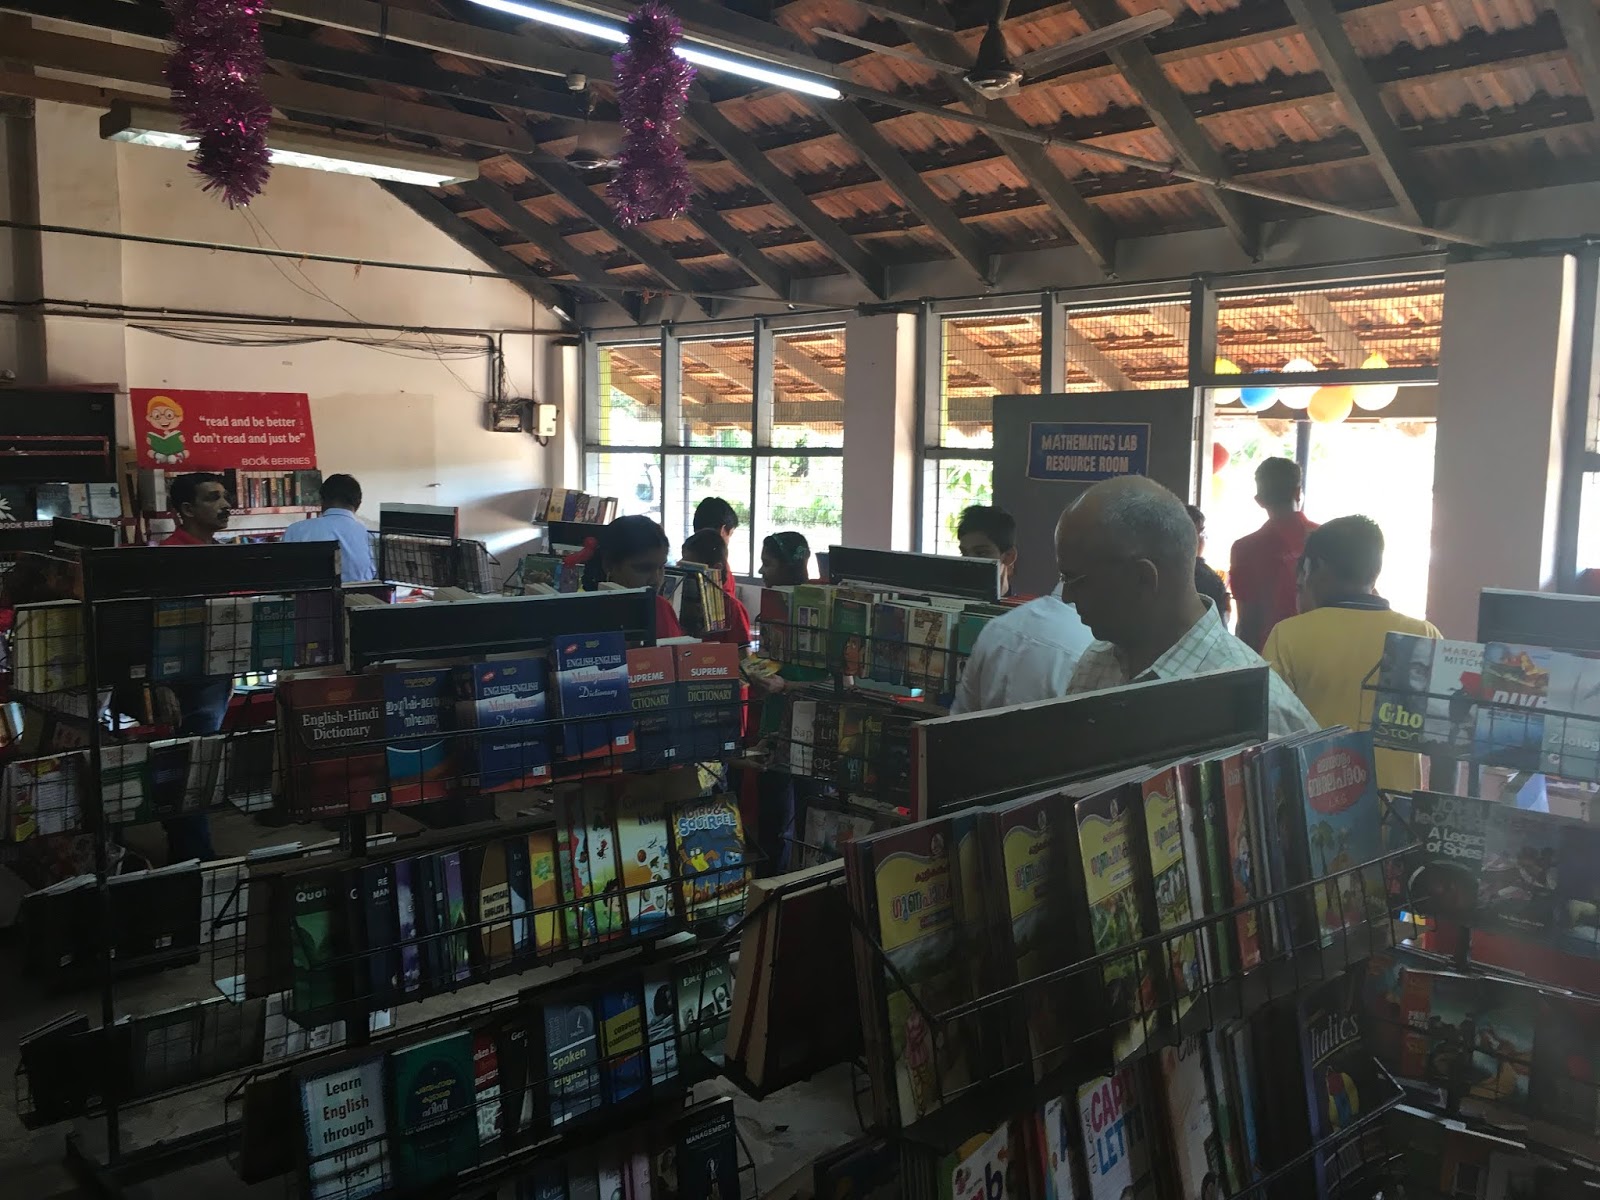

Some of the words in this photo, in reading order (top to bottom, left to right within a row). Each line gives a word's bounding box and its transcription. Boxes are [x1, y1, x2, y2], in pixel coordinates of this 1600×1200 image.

[230, 416, 251, 428] and
[252, 416, 265, 428] be
[267, 416, 296, 428] better
[223, 433, 249, 445] read
[251, 433, 267, 445] and
[268, 433, 286, 446] just
[1041, 434, 1116, 451] MATHEMATICS
[1118, 434, 1138, 451] LAB
[241, 457, 270, 468] BOOK
[271, 457, 310, 467] BERRIES
[1046, 456, 1096, 472] RESOURCE
[1099, 456, 1129, 473] ROOM
[690, 667, 728, 677] SUPREME
[578, 684, 618, 699] Dictionary
[687, 689, 732, 703] DICTIONARY
[632, 694, 670, 710] CTIONARY
[301, 707, 380, 729] English-Hindi
[1378, 702, 1423, 729] Gho
[313, 724, 372, 742] Dictionary
[1548, 732, 1600, 752] Zolog
[1428, 827, 1440, 839] A
[1426, 840, 1441, 853] of
[1443, 842, 1482, 861] Spies
[682, 966, 723, 987] EDUCTION
[1311, 1013, 1359, 1062] Italics
[552, 1047, 587, 1071] Spoken
[326, 1077, 362, 1097] Learn
[323, 1094, 369, 1121] English
[323, 1115, 374, 1144] through
[685, 1121, 732, 1145] MANAGEMENT
